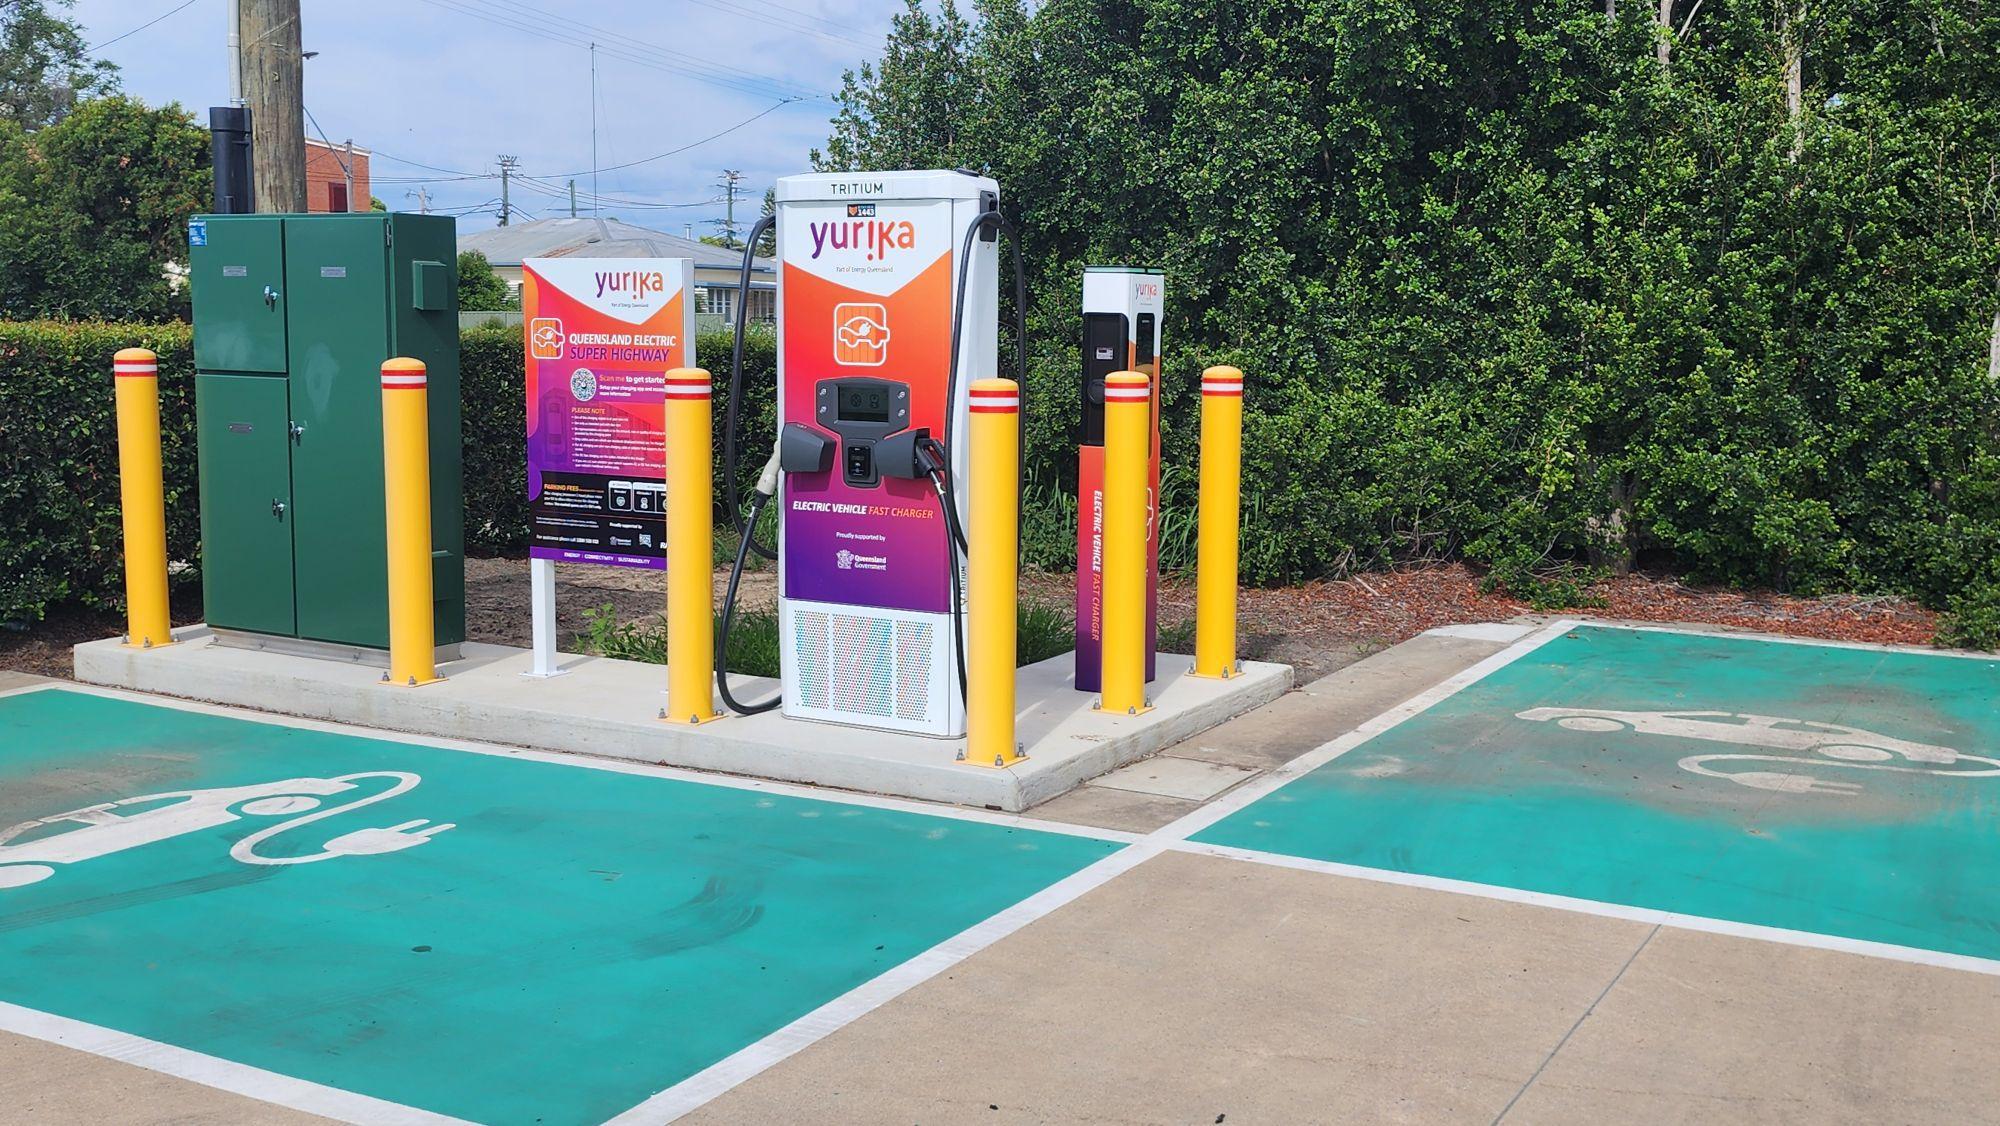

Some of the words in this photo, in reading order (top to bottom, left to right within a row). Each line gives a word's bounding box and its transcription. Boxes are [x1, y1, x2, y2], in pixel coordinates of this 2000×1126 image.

[831, 183, 883, 195] TRITIUM
[569, 333, 632, 346] QUEENSLAND
[634, 335, 677, 347] ELECTRIC
[570, 347, 607, 360] SUPER
[611, 348, 670, 362] HIGHWAY
[626, 375, 633, 383] to
[634, 376, 645, 385] get
[792, 500, 831, 513] ELECTRIC
[832, 504, 868, 515] VEHICLE
[868, 506, 890, 516] FAST
[891, 507, 934, 519] CHARGER
[1093, 490, 1103, 533] ELECTRIC
[836, 531, 854, 540] Proudly
[855, 533, 879, 541] supported
[879, 534, 886, 542] by
[854, 554, 887, 564] Queensland
[1092, 534, 1102, 573] VEHICLE
[854, 562, 887, 571] Government
[1092, 573, 1101, 596] FAST
[1091, 596, 1100, 641] CHARGER
